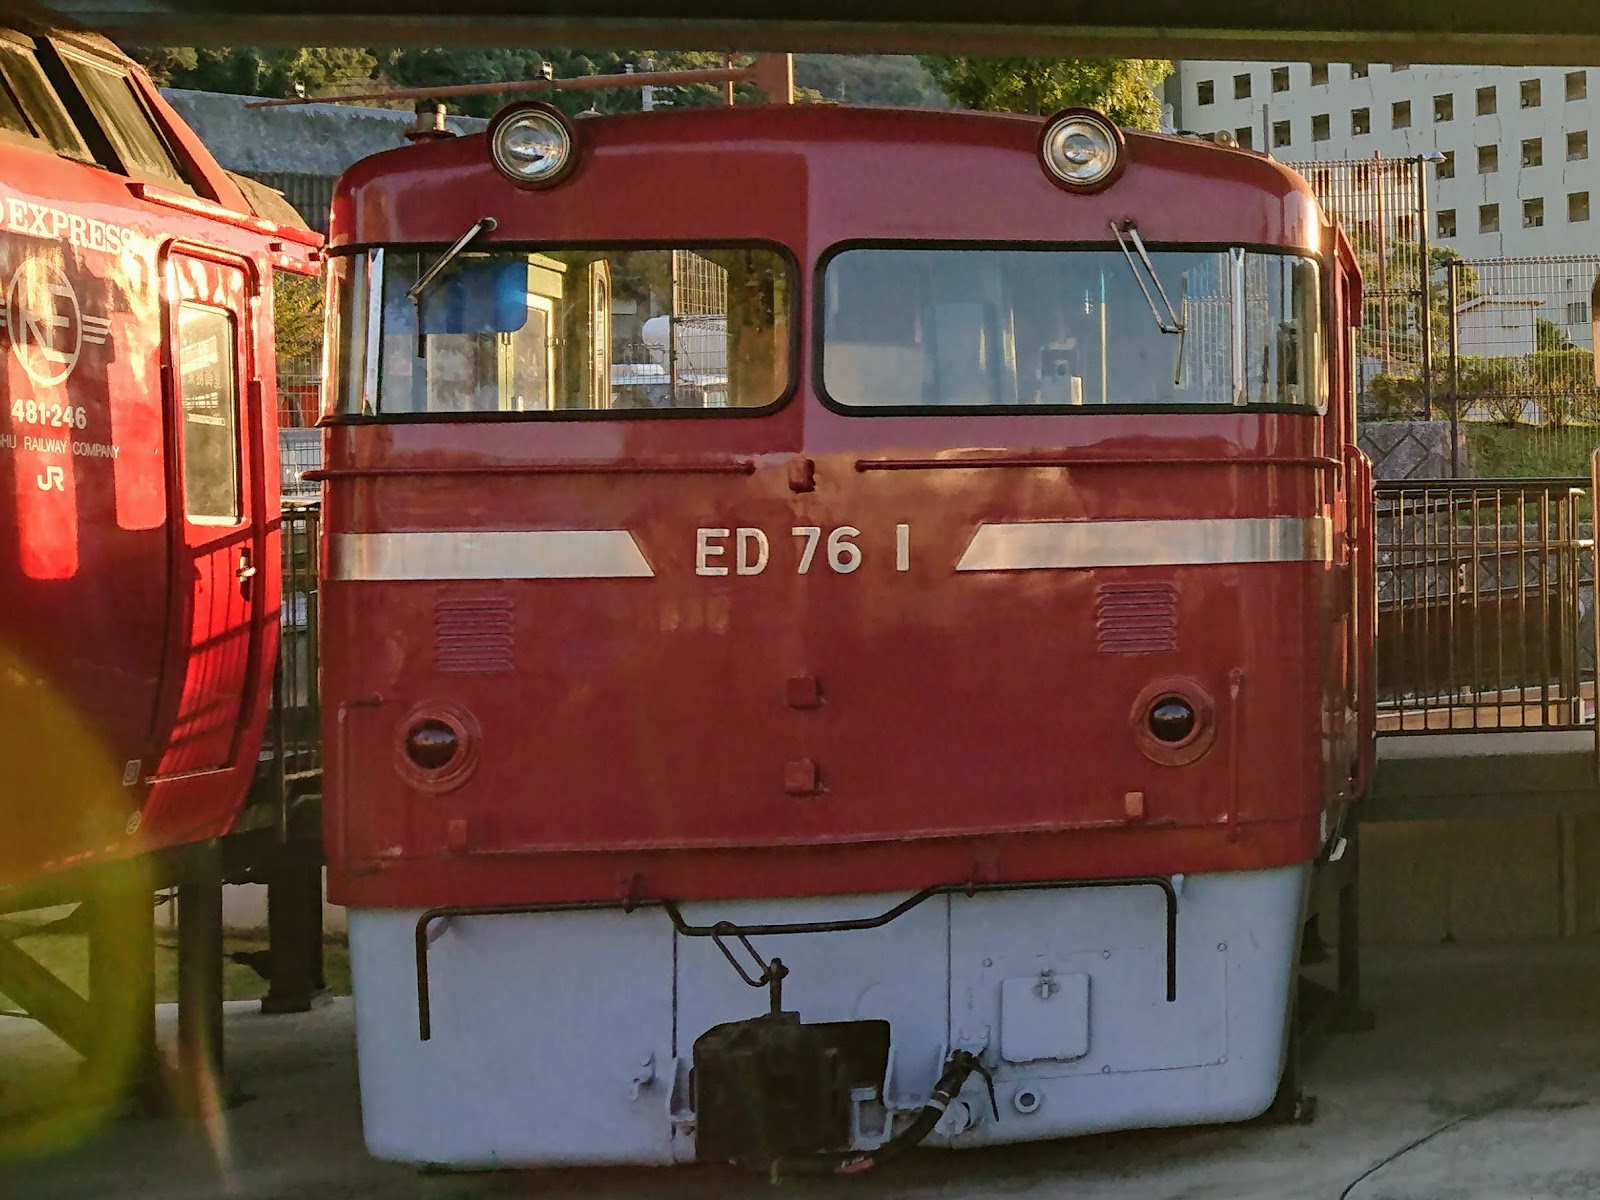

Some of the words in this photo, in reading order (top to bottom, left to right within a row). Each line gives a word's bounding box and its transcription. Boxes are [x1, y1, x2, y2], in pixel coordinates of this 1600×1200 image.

[0, 432, 17, 449] HU
[24, 435, 67, 455] RAILWAY
[73, 441, 120, 459] COMPANY
[37, 465, 65, 492] JR
[695, 527, 769, 576] ED
[791, 525, 862, 575] 76
